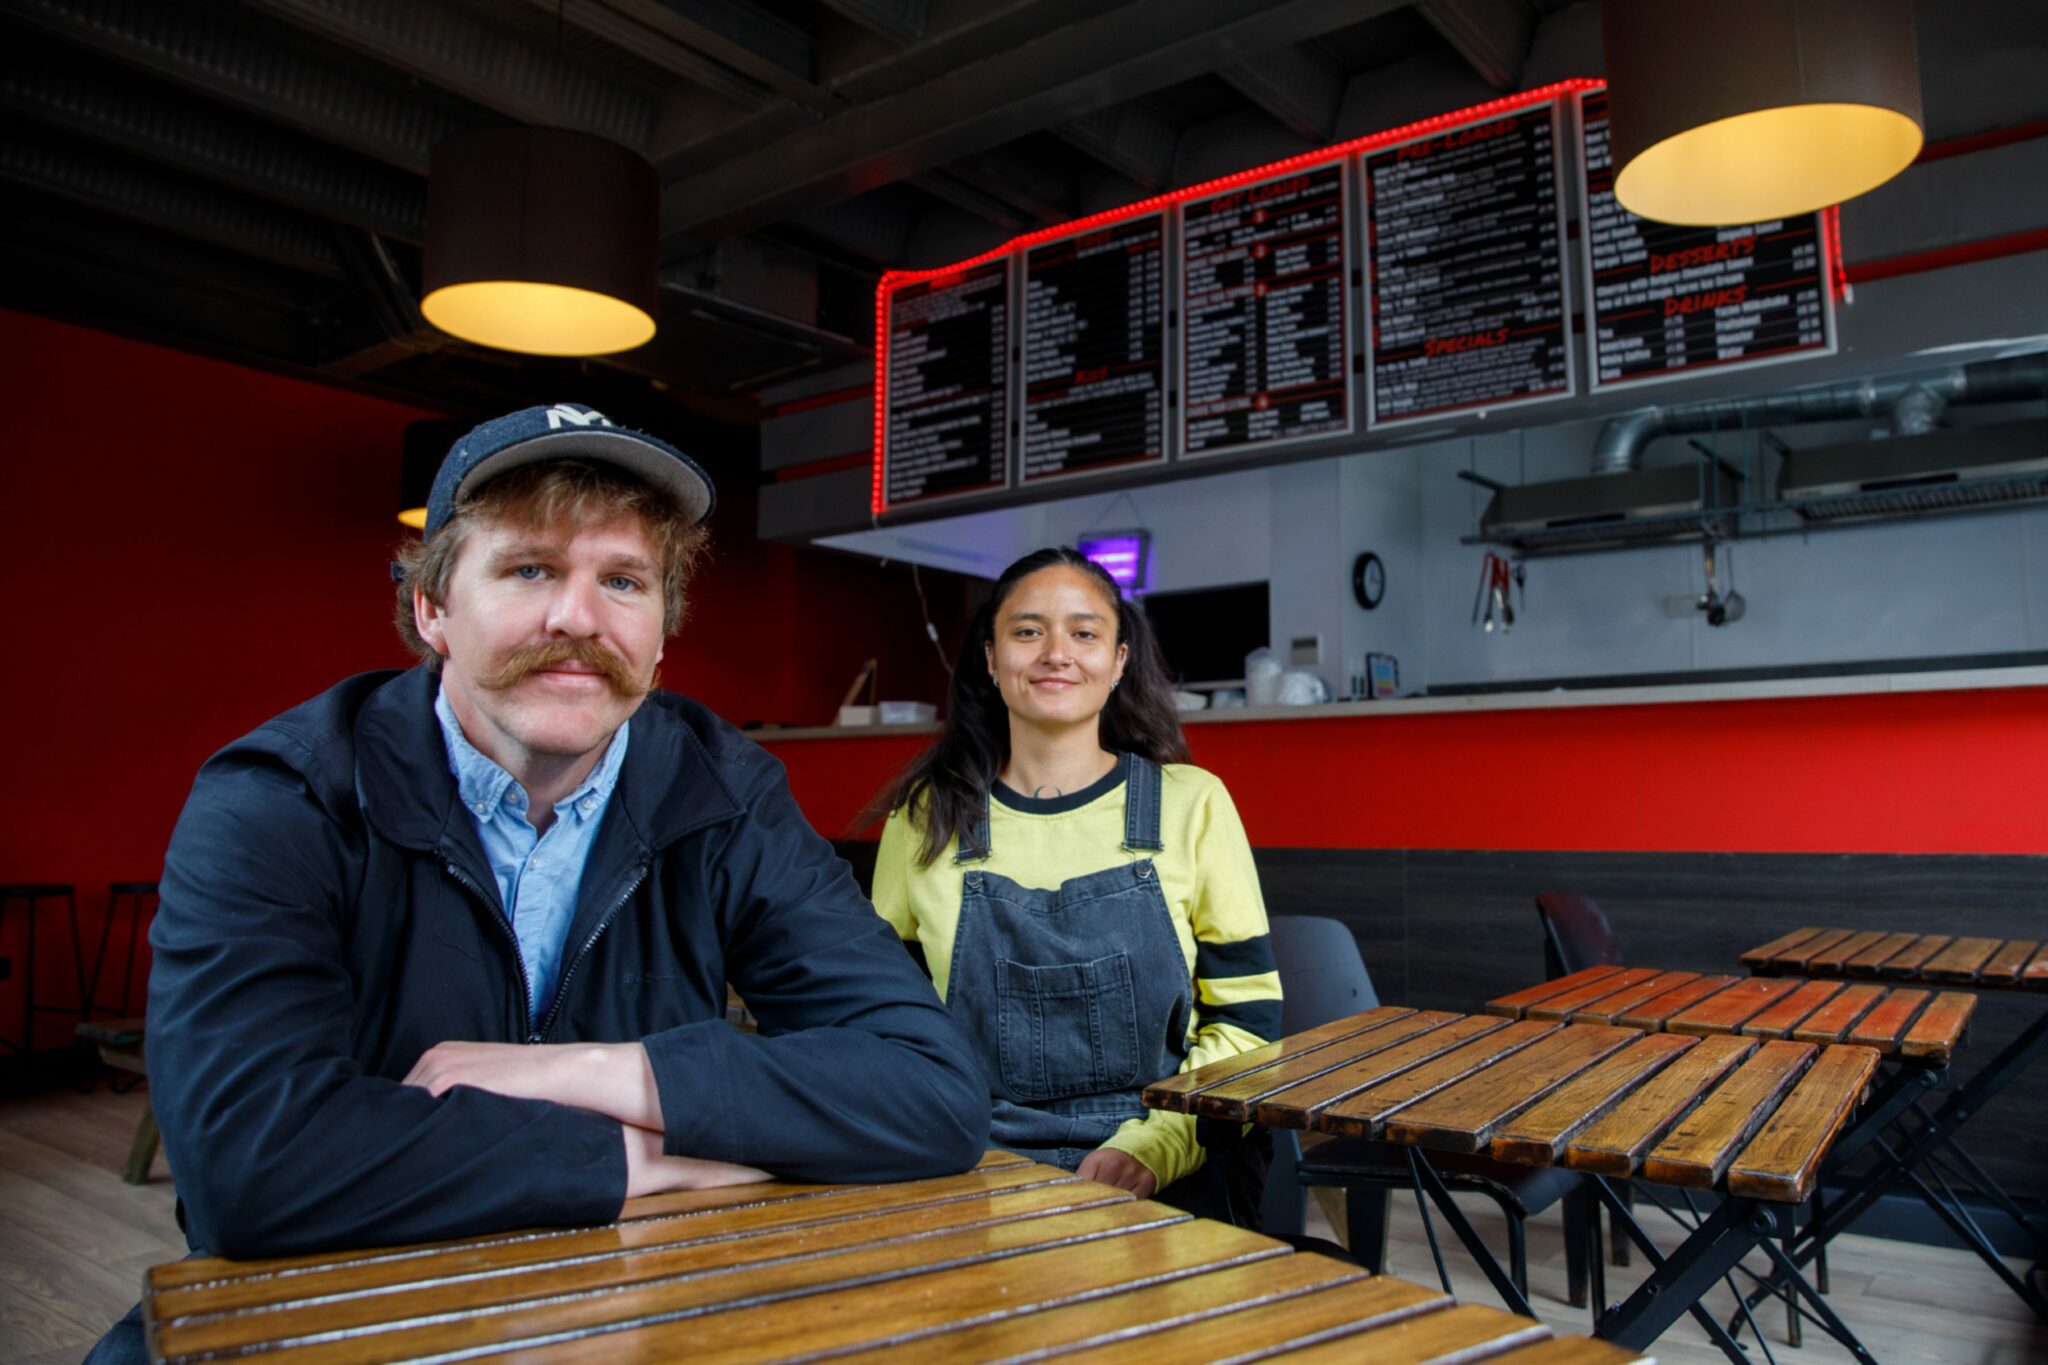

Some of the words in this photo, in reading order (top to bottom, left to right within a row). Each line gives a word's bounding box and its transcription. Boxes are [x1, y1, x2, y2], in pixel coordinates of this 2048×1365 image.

[1397, 118, 1519, 160] PRE-LOADED
[1650, 236, 1758, 273] DESSERTS
[1664, 284, 1750, 317] DRINKS
[1424, 327, 1509, 358] SPECIALS
